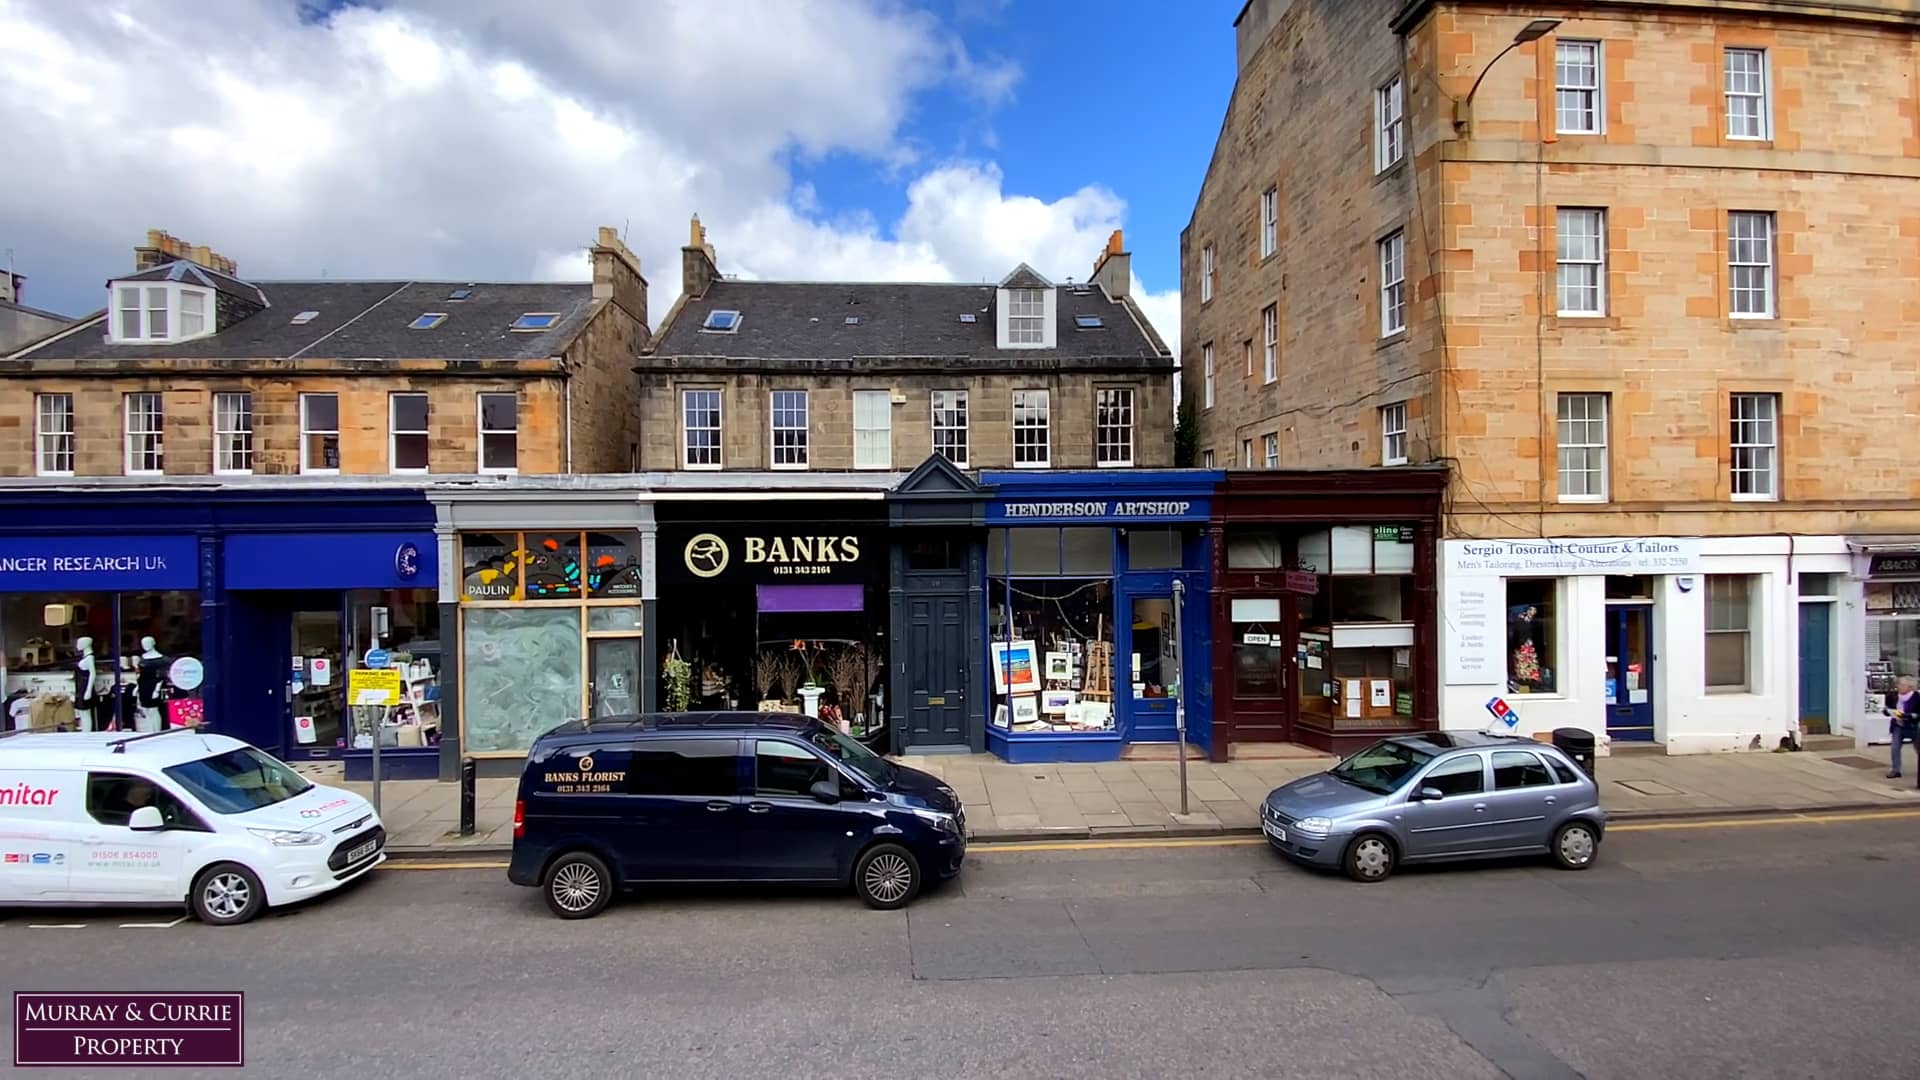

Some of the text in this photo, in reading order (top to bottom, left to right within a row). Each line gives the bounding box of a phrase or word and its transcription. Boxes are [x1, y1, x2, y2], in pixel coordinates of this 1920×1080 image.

[1005, 502, 1190, 517] HENDERSON ARTSHOP
[744, 536, 860, 563] BANKS
[1463, 542, 1680, 557] Sergio Tosoratti Couture & Tailors
[54, 557, 140, 571] RESEARCH
[145, 556, 167, 570] UK
[773, 566, 831, 574] 0131 343 2164
[1525, 559, 1577, 570] Dressmaking
[468, 585, 510, 595] PAULIN
[545, 772, 626, 783] BANKS FLORIST
[0, 783, 59, 805] mitar
